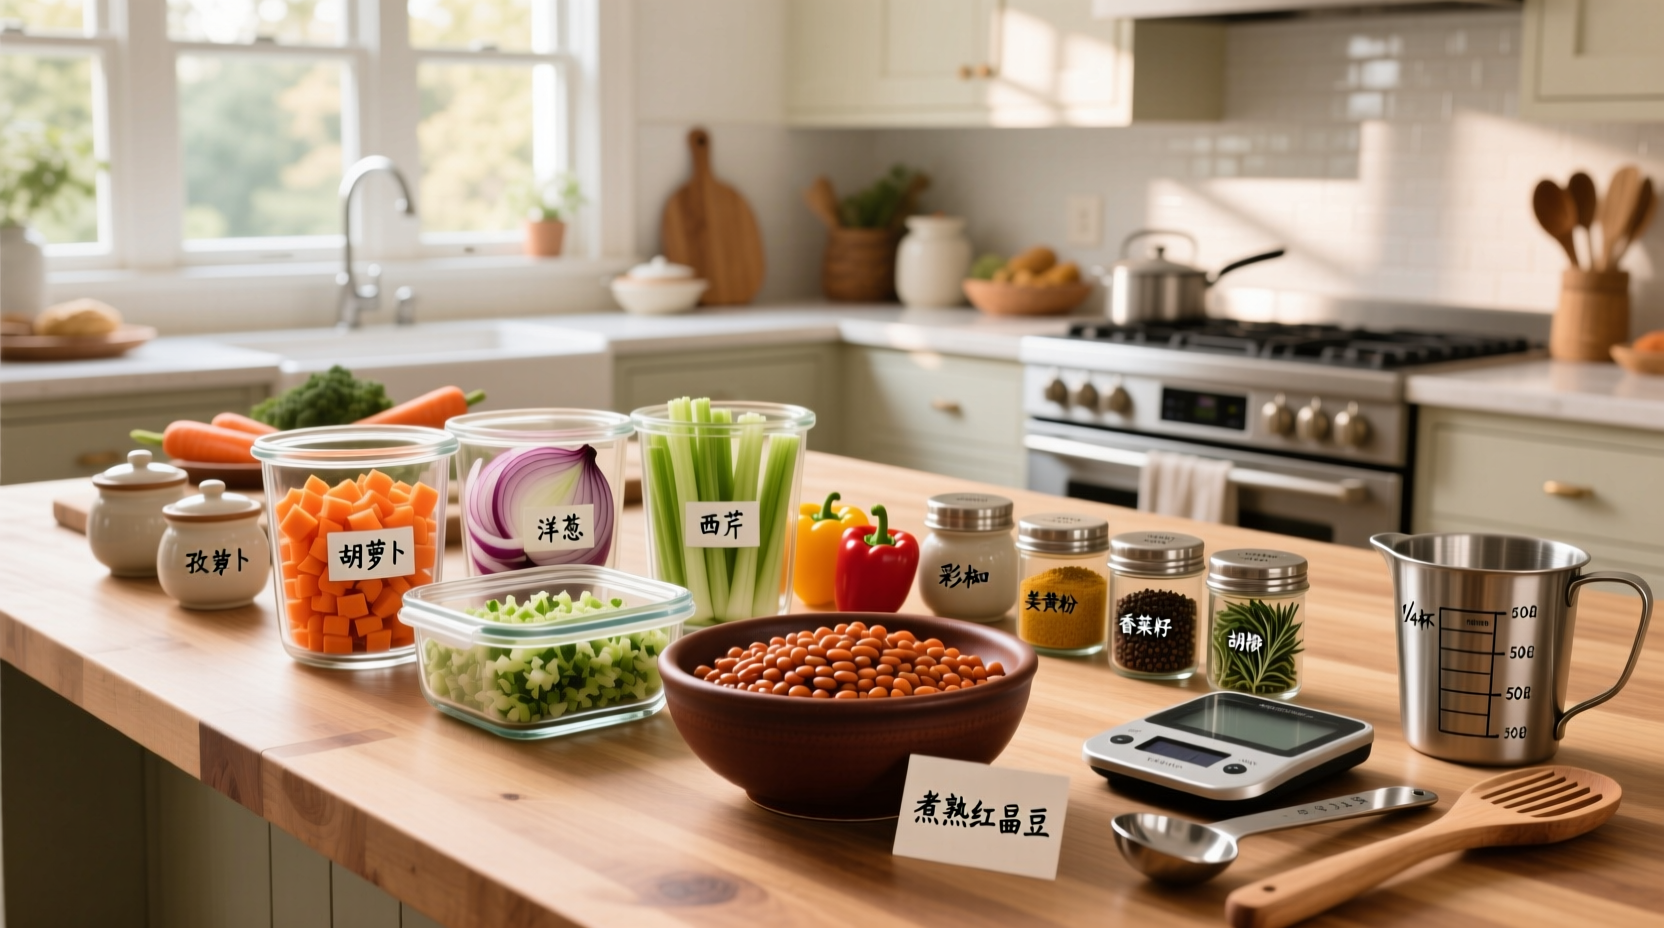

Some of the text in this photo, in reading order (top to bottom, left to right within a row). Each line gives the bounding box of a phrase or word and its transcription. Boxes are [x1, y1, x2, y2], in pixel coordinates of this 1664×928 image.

[537, 513, 584, 543] 洋葱
[700, 511, 743, 539] 西芹
[338, 539, 405, 570] 胡萝卜
